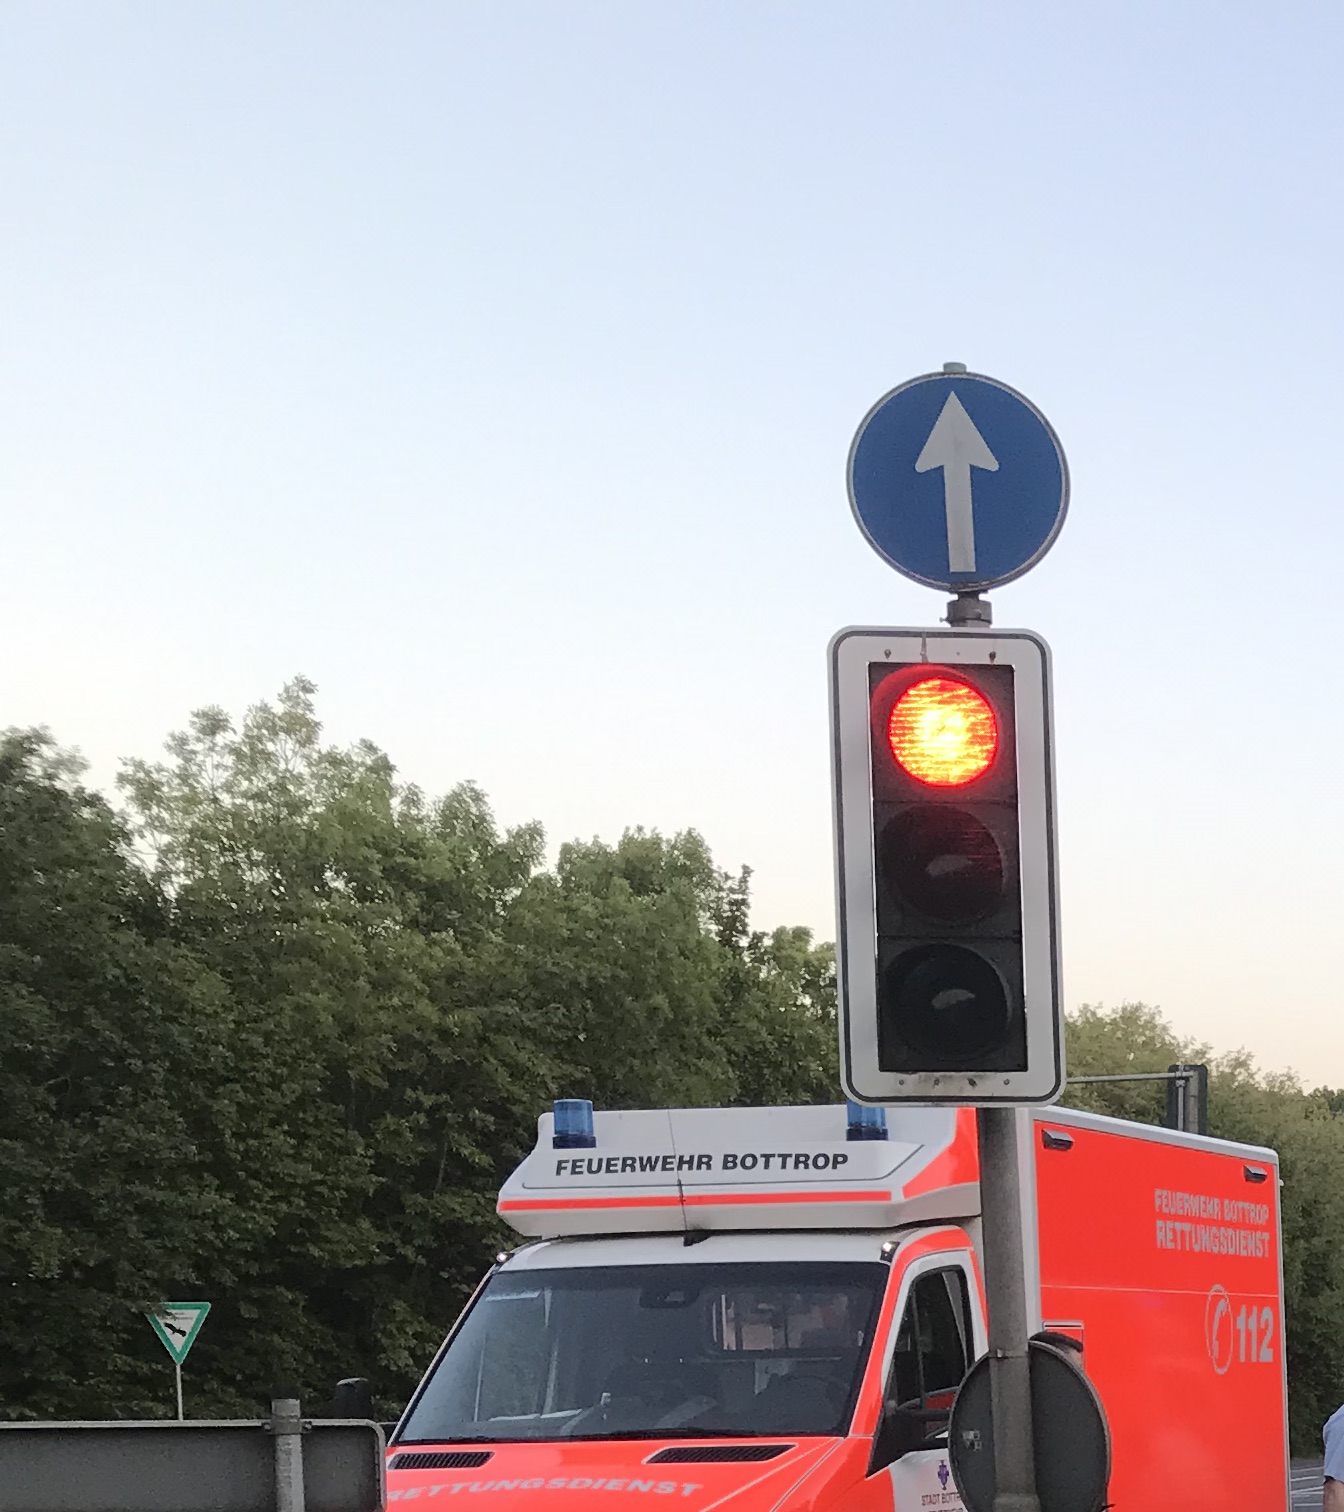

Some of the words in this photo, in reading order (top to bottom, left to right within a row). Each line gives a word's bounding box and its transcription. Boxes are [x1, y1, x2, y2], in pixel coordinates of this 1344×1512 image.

[556, 1154, 713, 1176] FEUERWEHR
[722, 1153, 848, 1170] BOTTROP
[1154, 1188, 1221, 1221] FEUERWEHR
[1223, 1198, 1269, 1225] BOTTROP
[1156, 1219, 1270, 1258] RETTUNGSDIENST
[1236, 1304, 1274, 1363] 112
[386, 1477, 704, 1502] RETTUNGSDIENST
